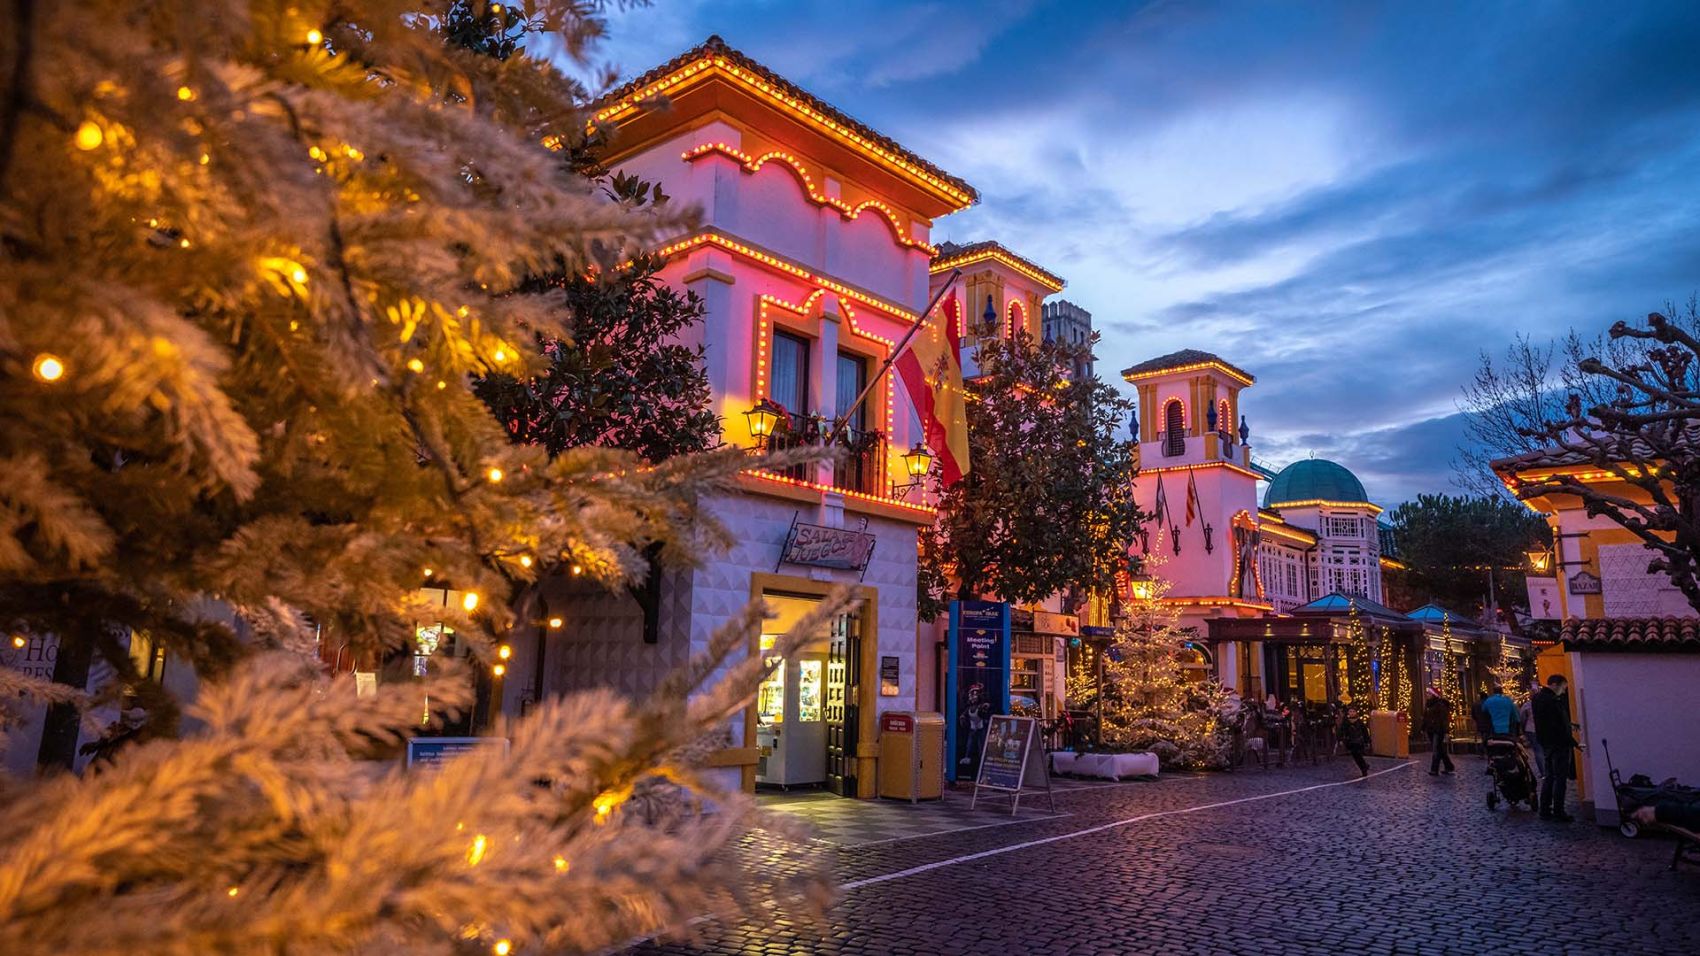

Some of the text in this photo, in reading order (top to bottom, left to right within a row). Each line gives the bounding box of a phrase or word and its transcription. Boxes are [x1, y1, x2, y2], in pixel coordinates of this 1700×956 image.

[796, 527, 840, 546] SALA
[785, 540, 848, 562] JUEGOS
[966, 636, 995, 645] Meeting
